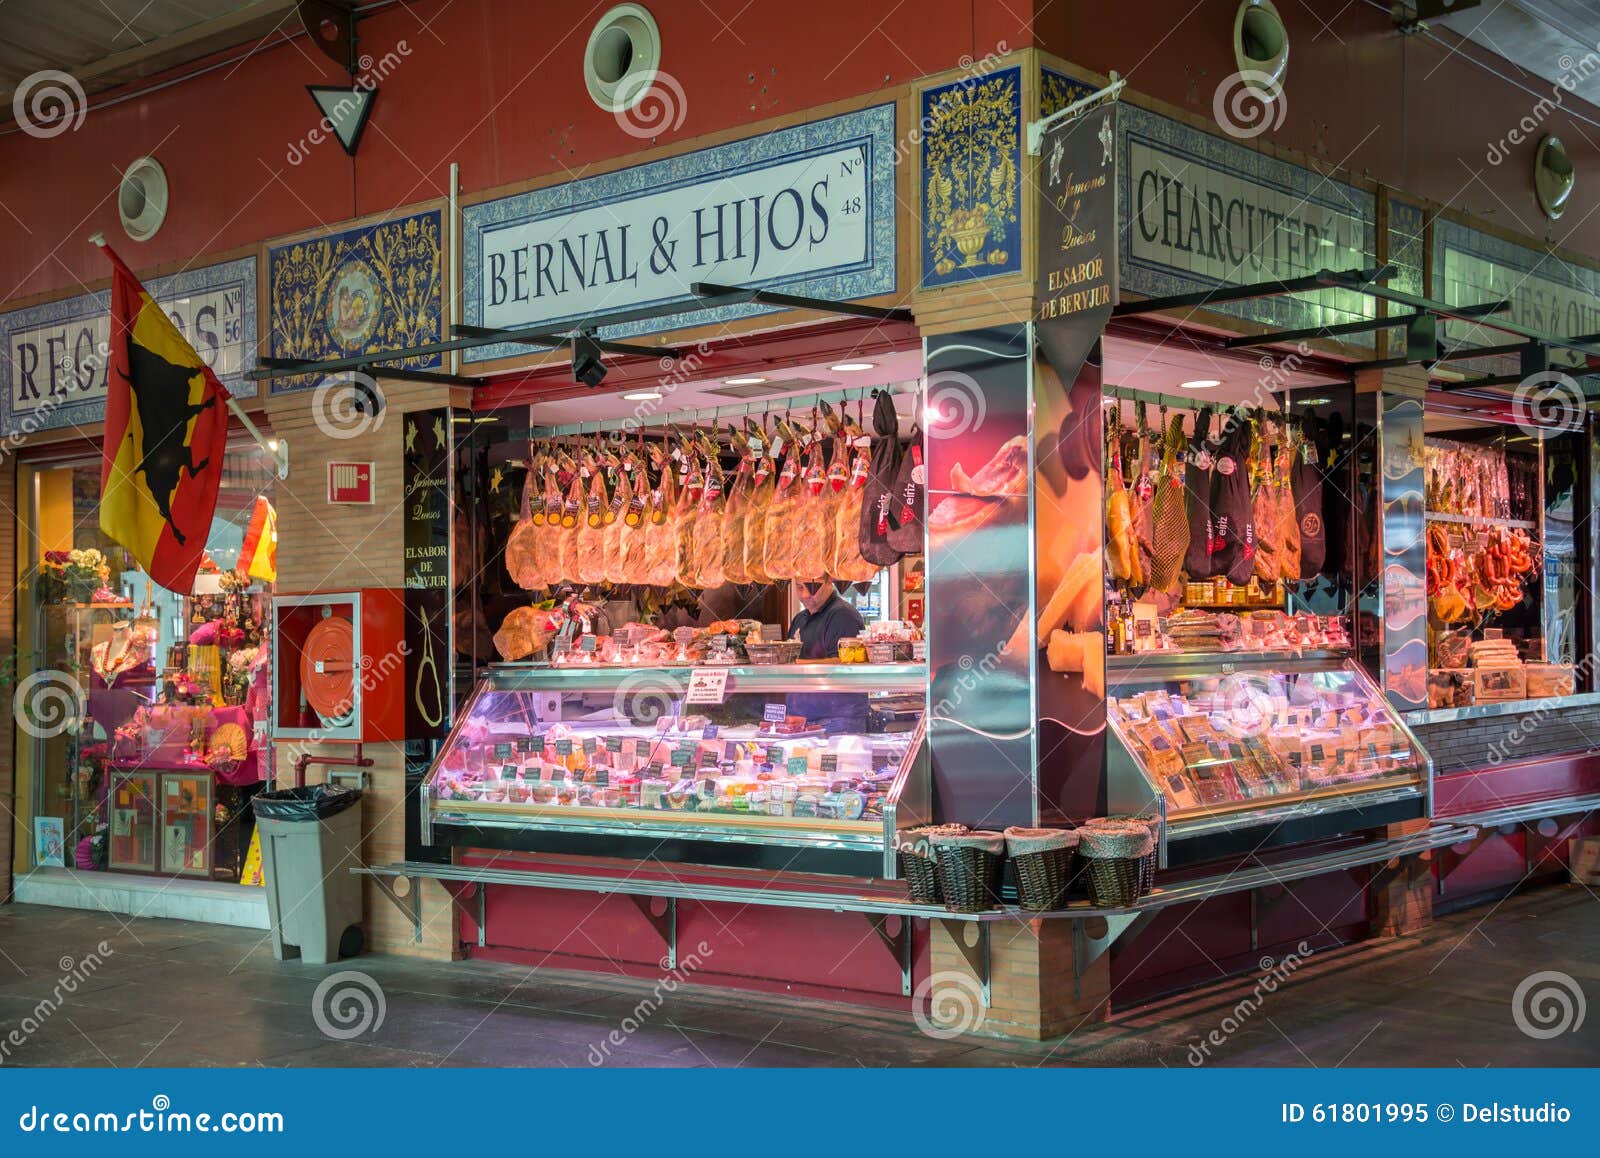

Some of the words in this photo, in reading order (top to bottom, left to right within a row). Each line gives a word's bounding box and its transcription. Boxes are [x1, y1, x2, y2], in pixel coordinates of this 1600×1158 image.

[1057, 172, 1106, 211] Jamones
[841, 197, 862, 216] 48
[1072, 199, 1081, 221] y
[488, 224, 638, 307] BERNAL
[650, 216, 678, 275] &
[692, 174, 830, 275] HIJOS
[1061, 225, 1096, 250] Quesos
[1049, 271, 1063, 291] EL
[1064, 258, 1103, 287] SABOR
[1041, 299, 1057, 320] DE
[1059, 284, 1110, 315] BERYJUR
[225, 318, 241, 343] 56
[17, 301, 219, 400] REGS
[406, 472, 447, 495] Jamones
[412, 504, 441, 521] Quesos
[406, 548, 417, 558] EL
[417, 545, 447, 557] SABOR
[420, 561, 433, 573] DE
